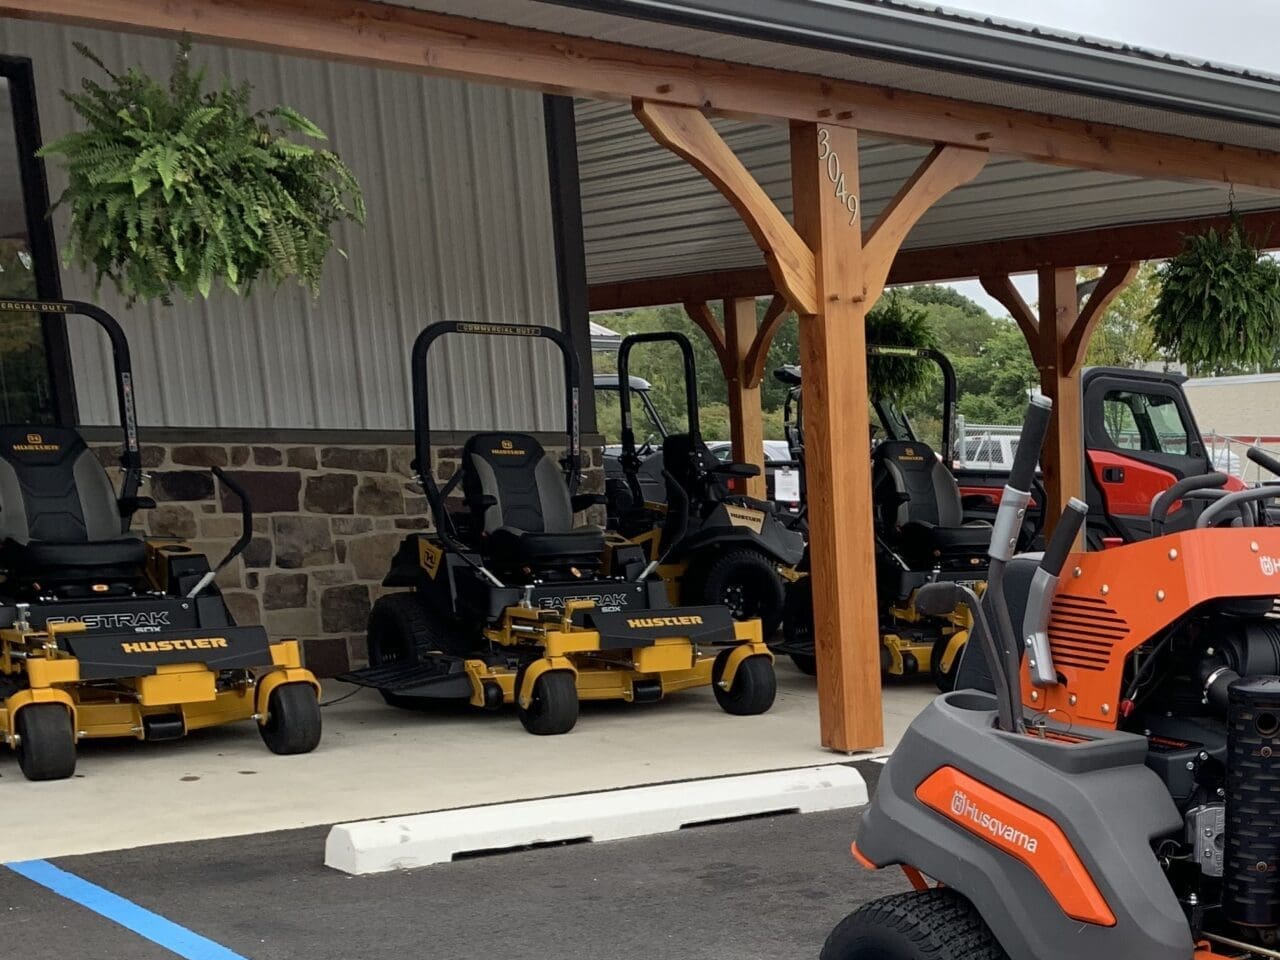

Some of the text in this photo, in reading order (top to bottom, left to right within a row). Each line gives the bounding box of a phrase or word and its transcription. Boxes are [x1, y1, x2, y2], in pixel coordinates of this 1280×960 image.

[818, 128, 858, 226] 3049
[41, 304, 68, 312] DUTY
[626, 615, 704, 629] HUSTLER
[120, 637, 229, 654] HUSTLER
[964, 799, 1038, 854] Husqvarna
